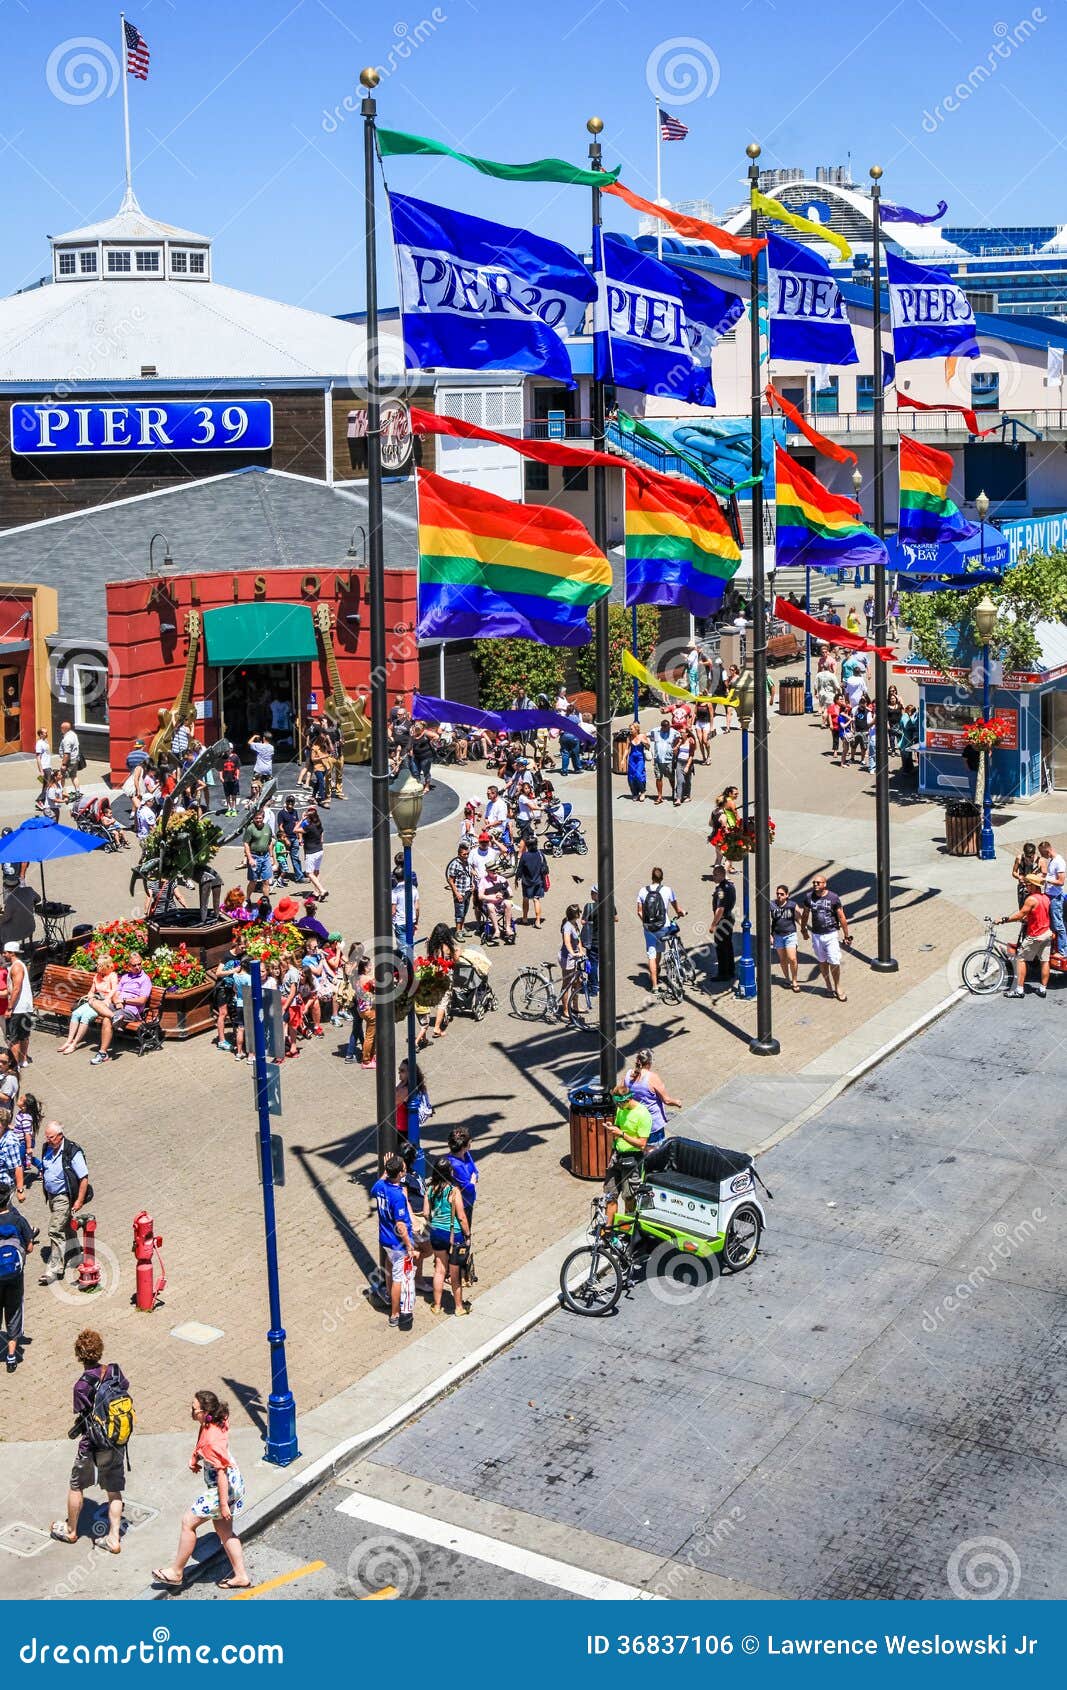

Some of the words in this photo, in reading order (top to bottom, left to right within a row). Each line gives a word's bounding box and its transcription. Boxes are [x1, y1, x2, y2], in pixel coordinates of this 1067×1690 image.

[411, 254, 534, 316] PIER
[897, 288, 958, 323] PIER
[37, 408, 174, 448] PIER
[191, 407, 249, 444] 39
[917, 550, 938, 561] BAY
[996, 546, 1007, 560] BAY
[1003, 526, 1024, 563] THE
[1026, 522, 1046, 556] BAY
